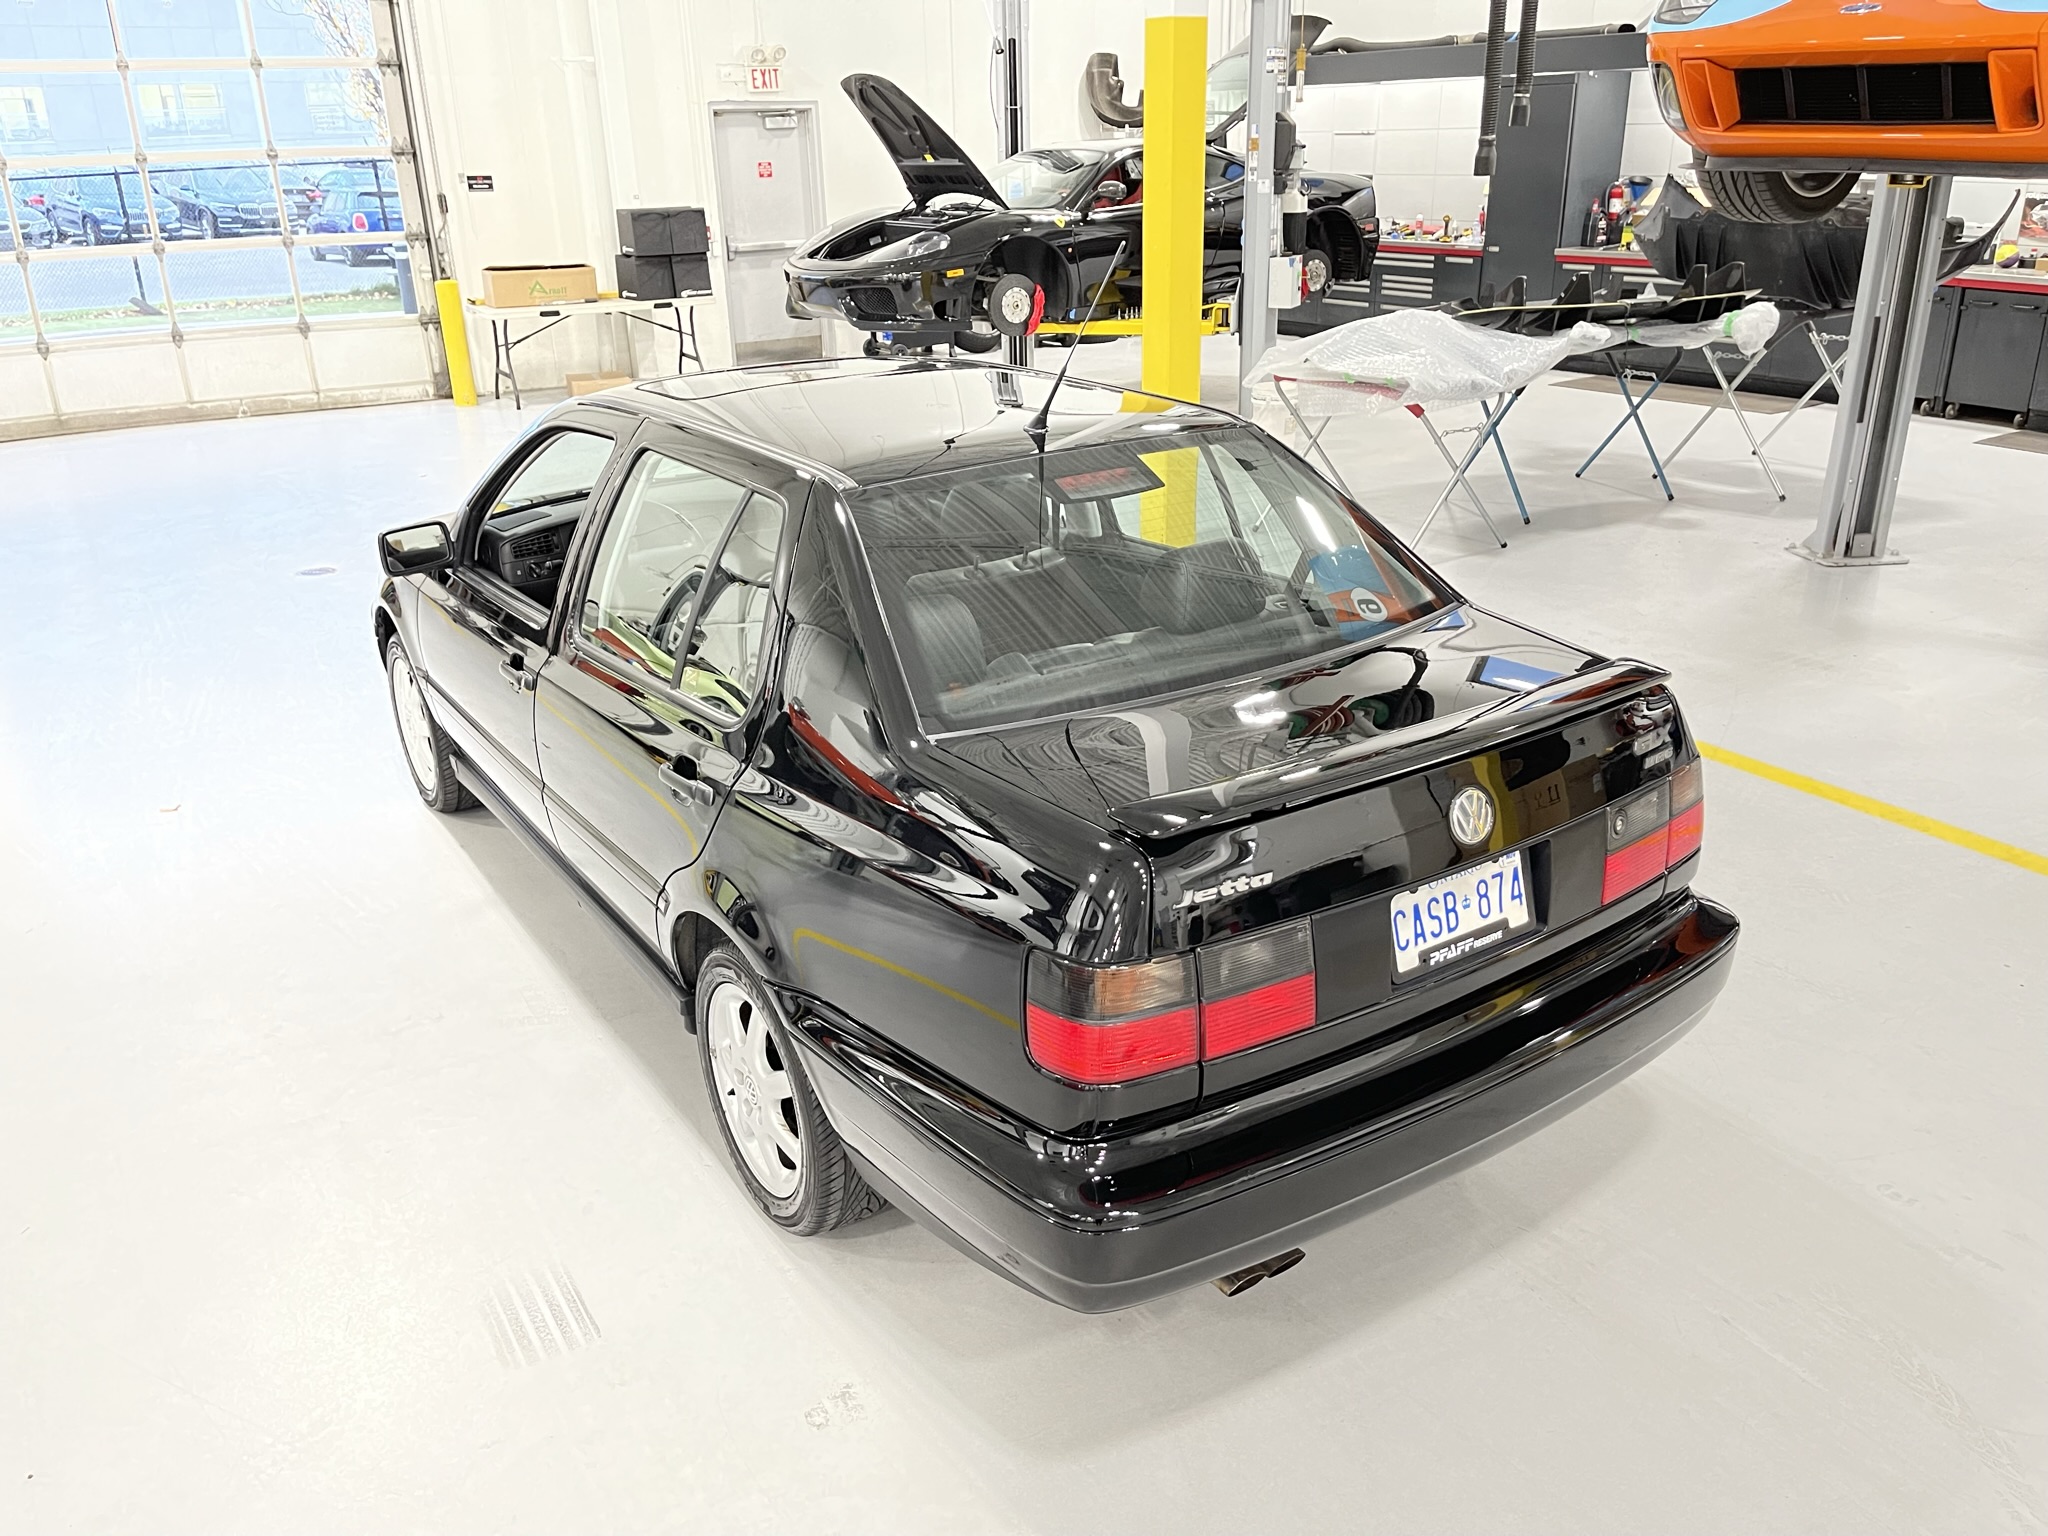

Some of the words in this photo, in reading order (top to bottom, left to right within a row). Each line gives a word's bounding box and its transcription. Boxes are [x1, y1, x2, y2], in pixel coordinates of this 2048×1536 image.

[751, 68, 780, 90] EXIT
[1173, 871, 1274, 910] Jetta
[1393, 890, 1460, 951] CASB
[1476, 866, 1524, 920] 874
[1430, 937, 1475, 966] PFAFF
[1473, 930, 1503, 949] RESERVE
